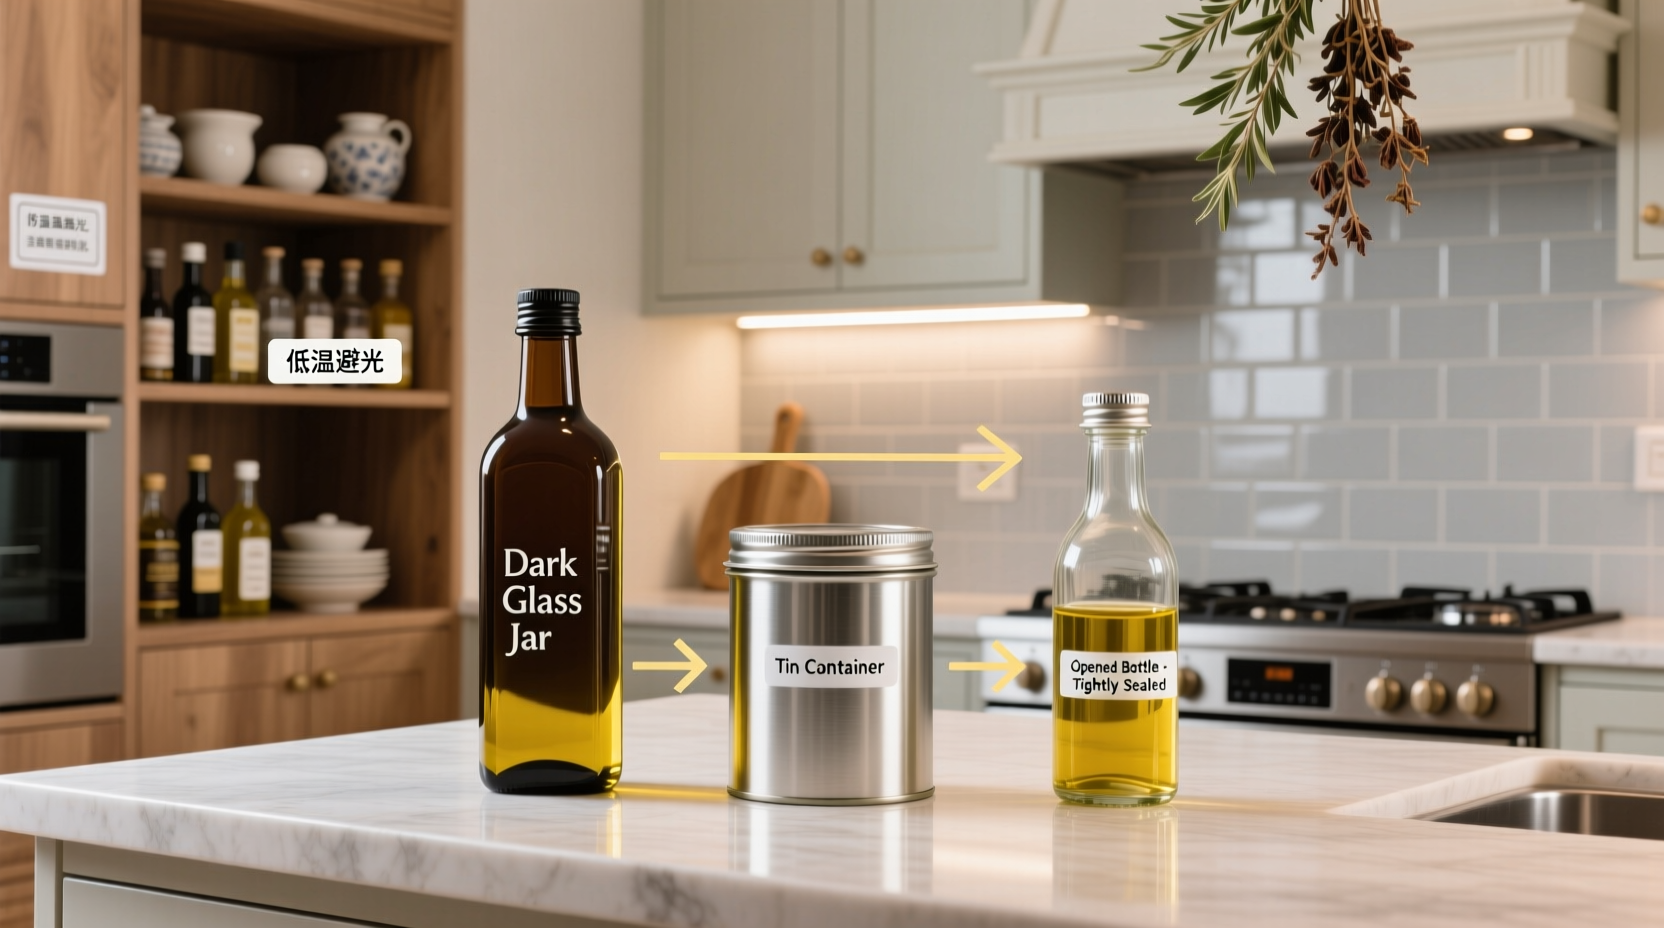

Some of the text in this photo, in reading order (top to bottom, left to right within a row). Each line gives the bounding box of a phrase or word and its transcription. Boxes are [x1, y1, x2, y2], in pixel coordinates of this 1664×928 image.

[504, 547, 578, 577] Dark
[502, 585, 582, 614] Glass
[505, 622, 552, 657] Jar
[775, 657, 885, 675] Tin Container
[1070, 659, 1117, 675] Opened
[1121, 659, 1159, 673] Bottle
[1072, 677, 1166, 695] Tightly Sealed
